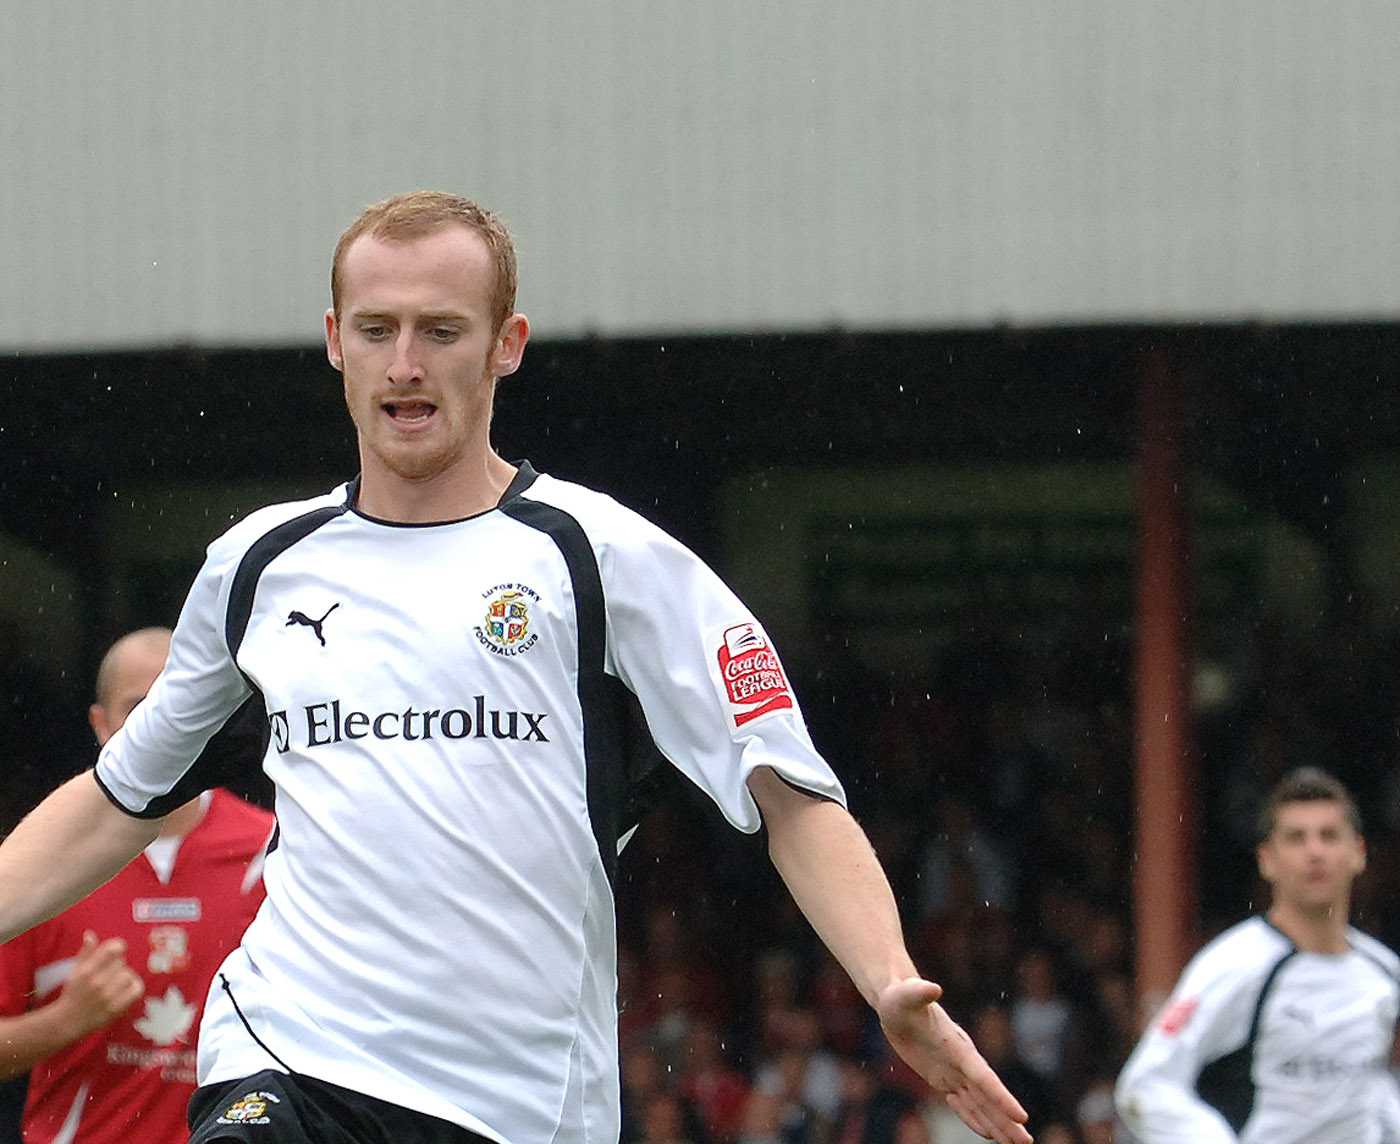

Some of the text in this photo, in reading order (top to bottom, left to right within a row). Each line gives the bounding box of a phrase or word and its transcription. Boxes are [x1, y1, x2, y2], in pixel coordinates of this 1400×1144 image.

[473, 626, 538, 656] FOOTBALL CLUB
[303, 694, 551, 748] Electrolux
